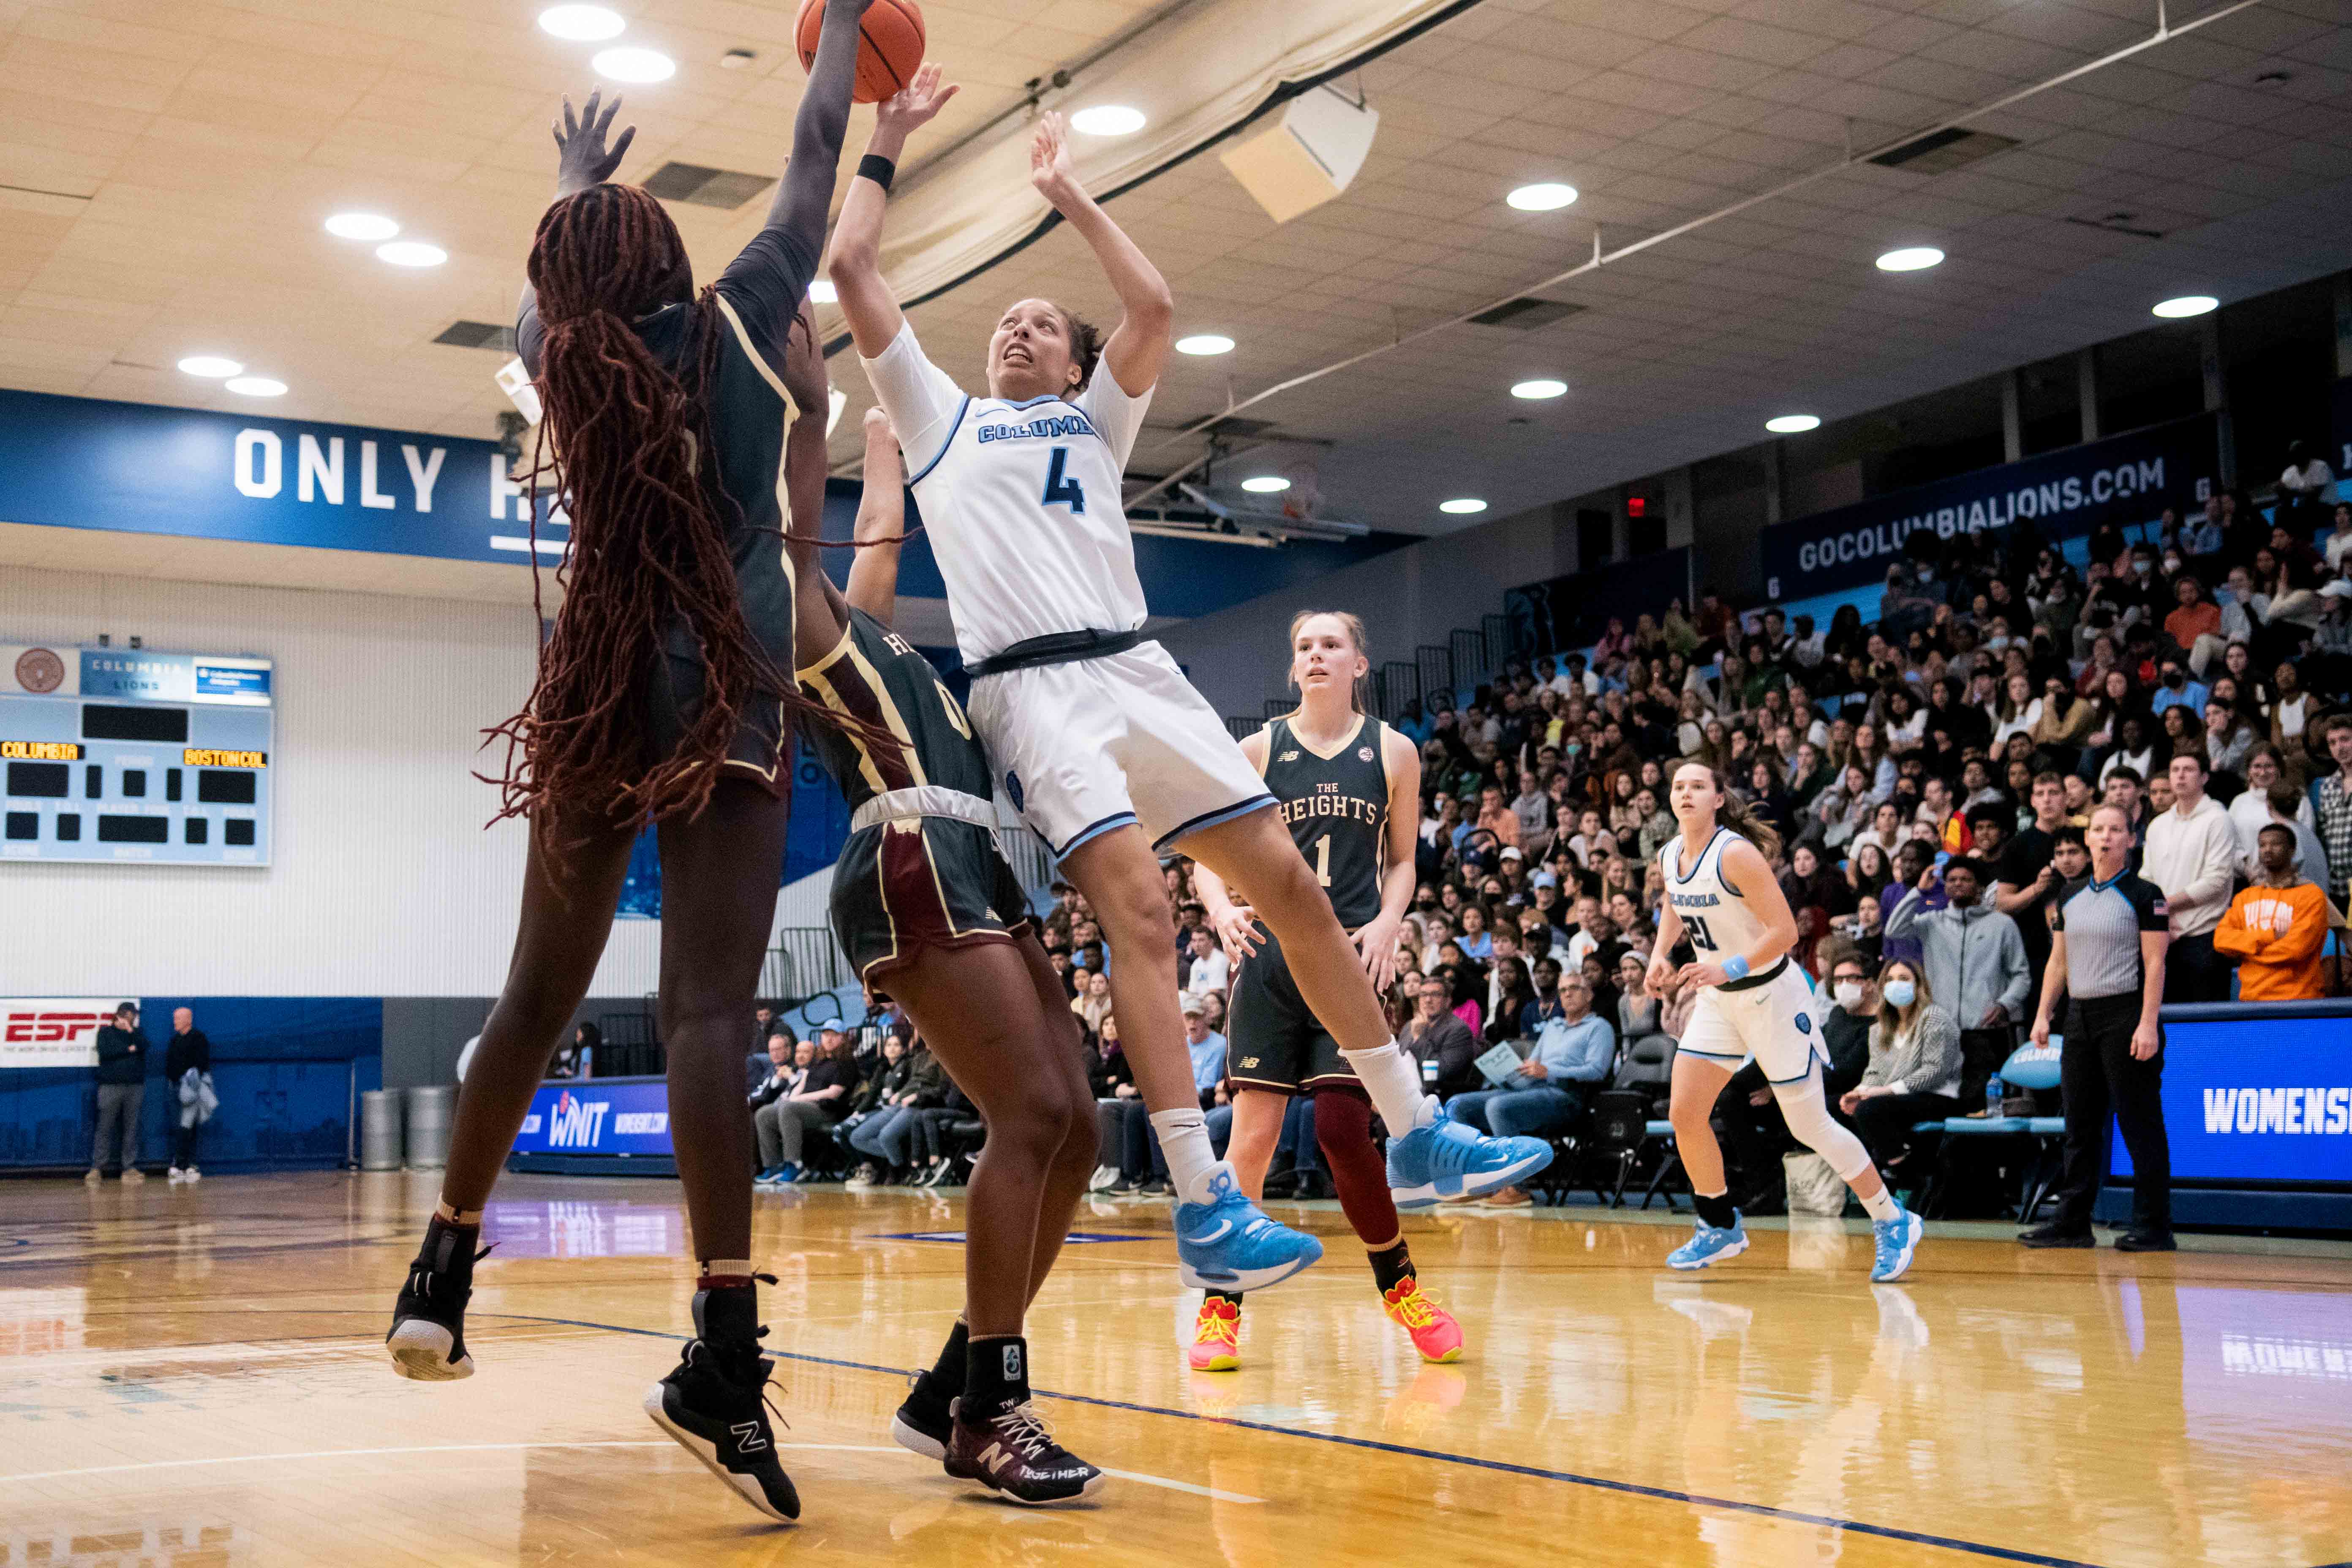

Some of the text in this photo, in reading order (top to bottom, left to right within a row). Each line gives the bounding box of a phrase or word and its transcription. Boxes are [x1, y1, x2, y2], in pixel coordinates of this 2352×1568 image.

[235, 427, 446, 513] ONLY
[1042, 446, 1086, 514] 4
[1, 741, 78, 760] COLUMBIA
[1316, 783, 1338, 793] THE
[1279, 795, 1377, 825] HEIGHTS
[1315, 834, 1331, 887] 1
[1680, 915, 1718, 950] 21
[5, 1013, 120, 1041] ESP
[2203, 1087, 2352, 1135] WOMENS
